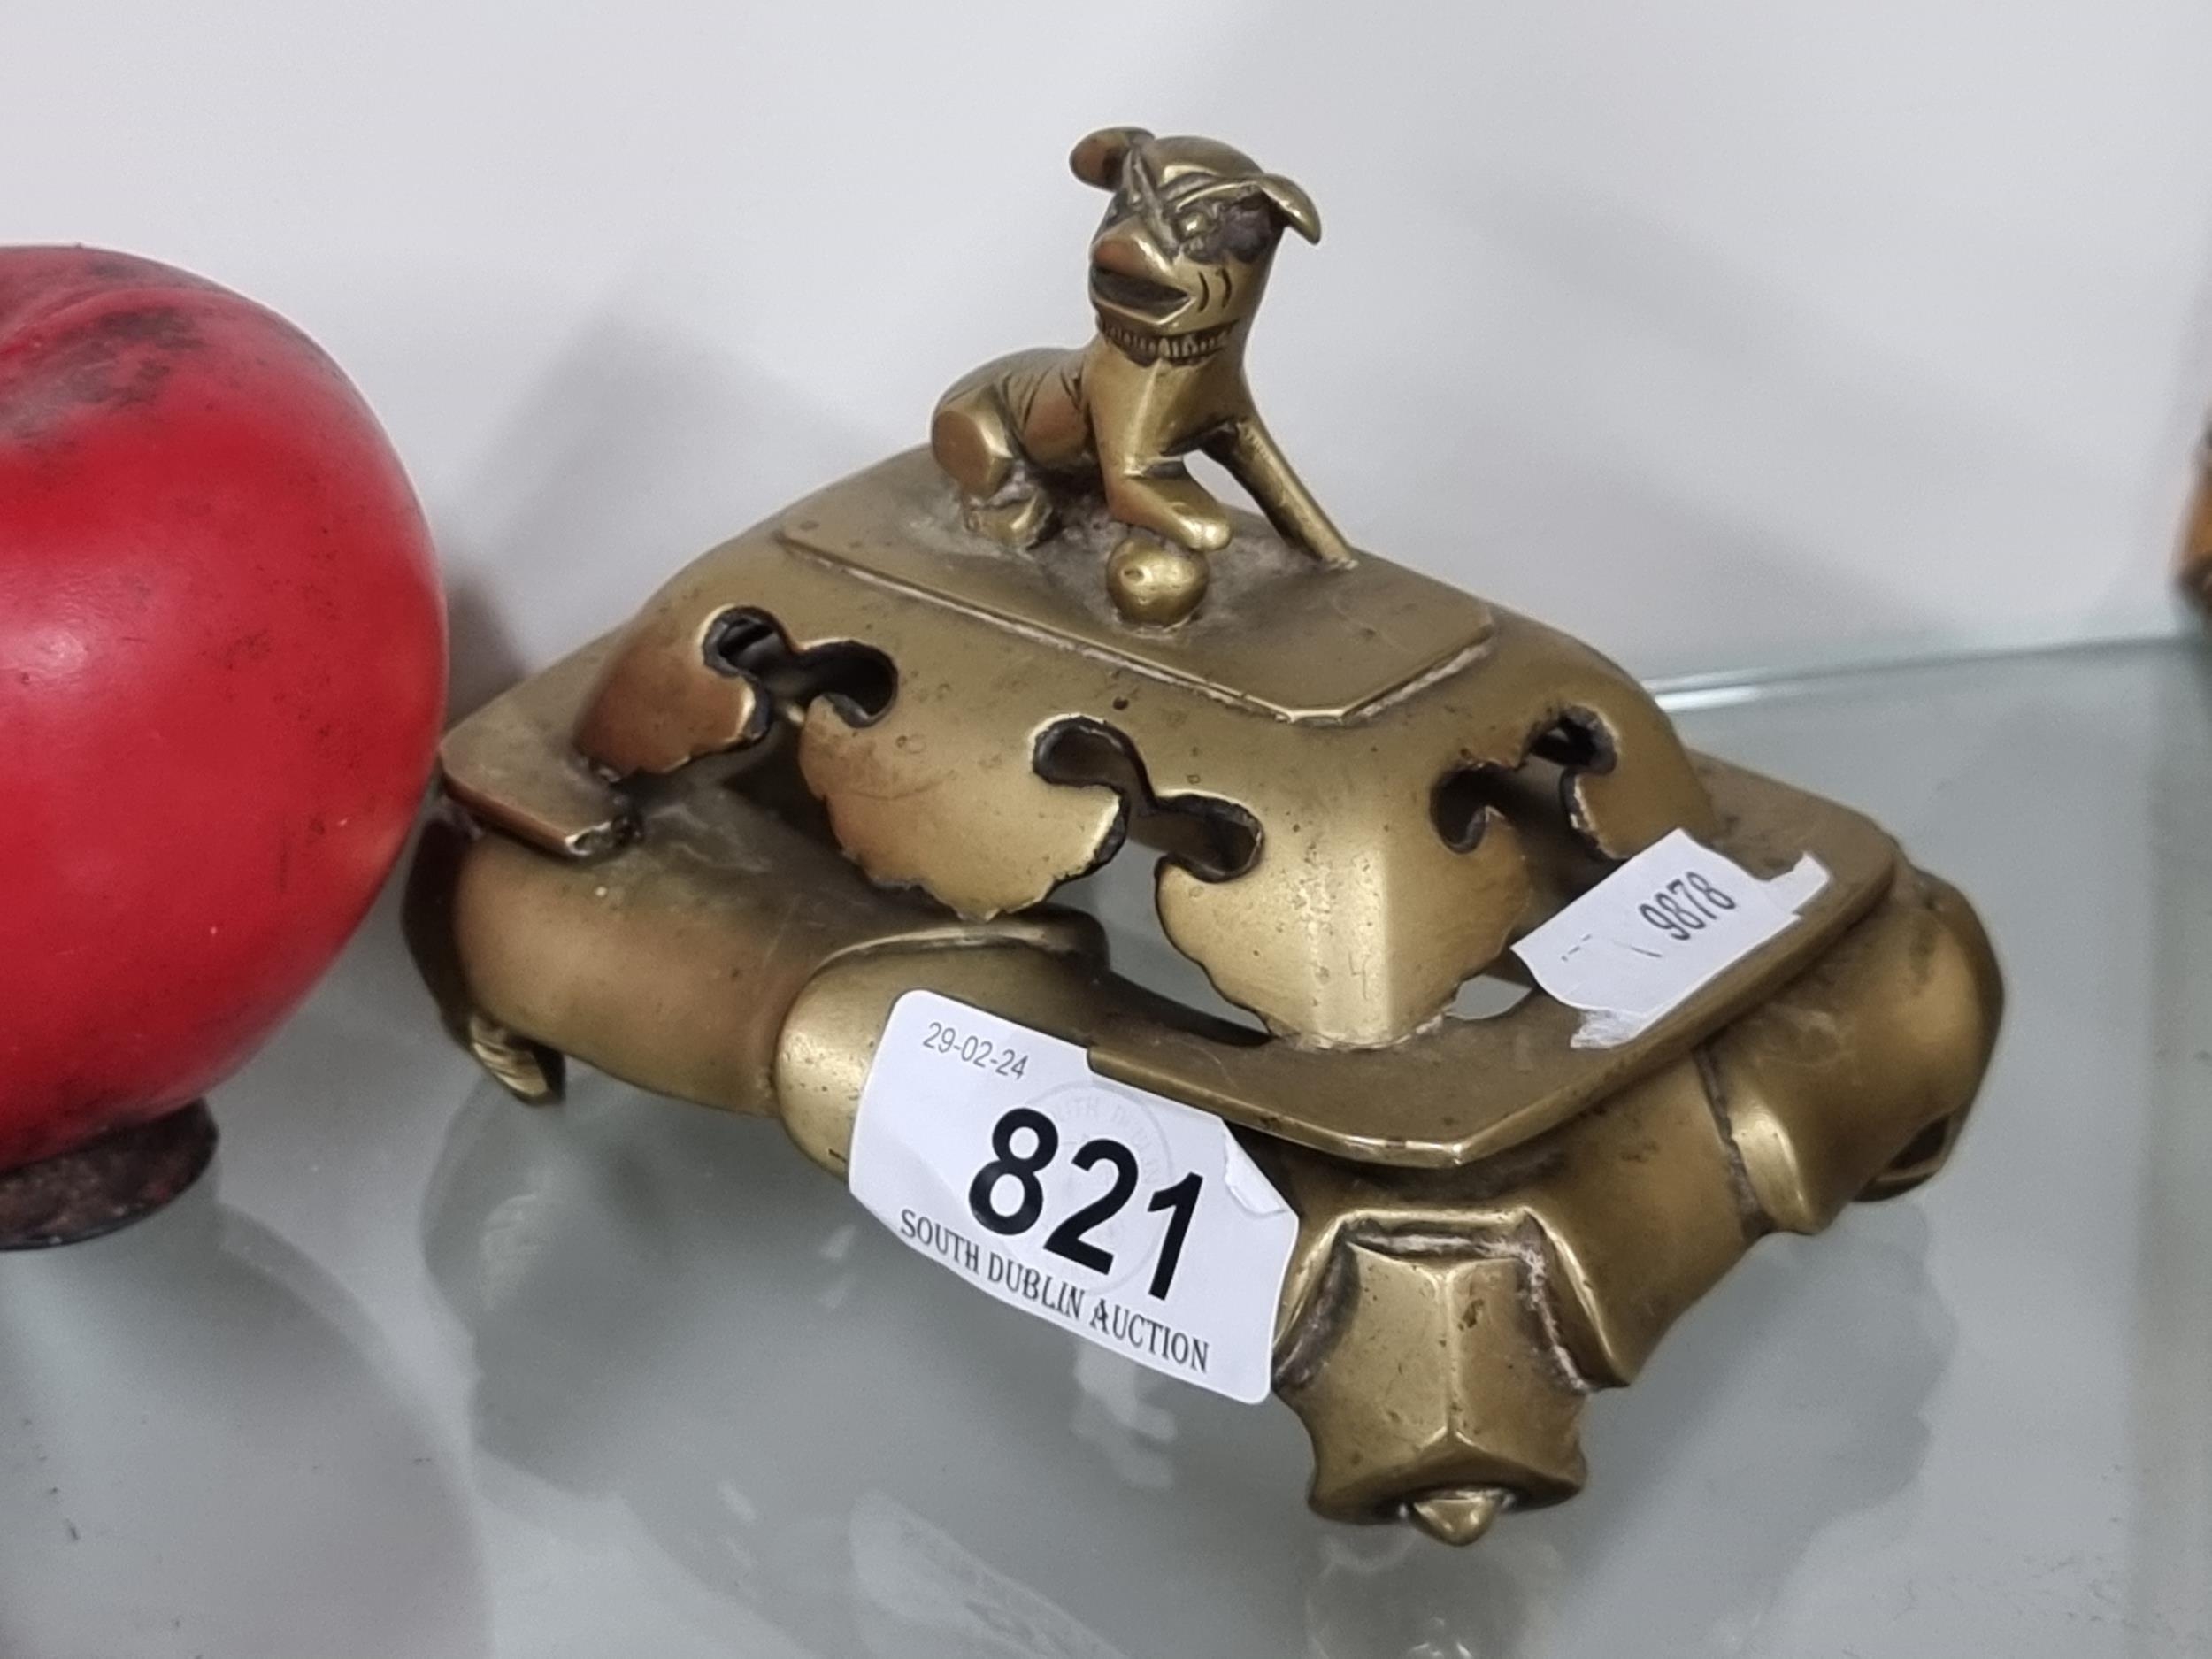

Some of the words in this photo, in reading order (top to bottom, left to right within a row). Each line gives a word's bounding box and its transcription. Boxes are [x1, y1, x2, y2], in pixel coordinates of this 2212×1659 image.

[1639, 872, 1737, 941] 9878
[922, 1022, 1029, 1080] 29-02-24
[969, 1108, 1203, 1301] 821
[900, 1209, 979, 1272] SOUTH
[987, 1253, 1085, 1319] DUBLIN
[1089, 1299, 1210, 1373] AUCTION
